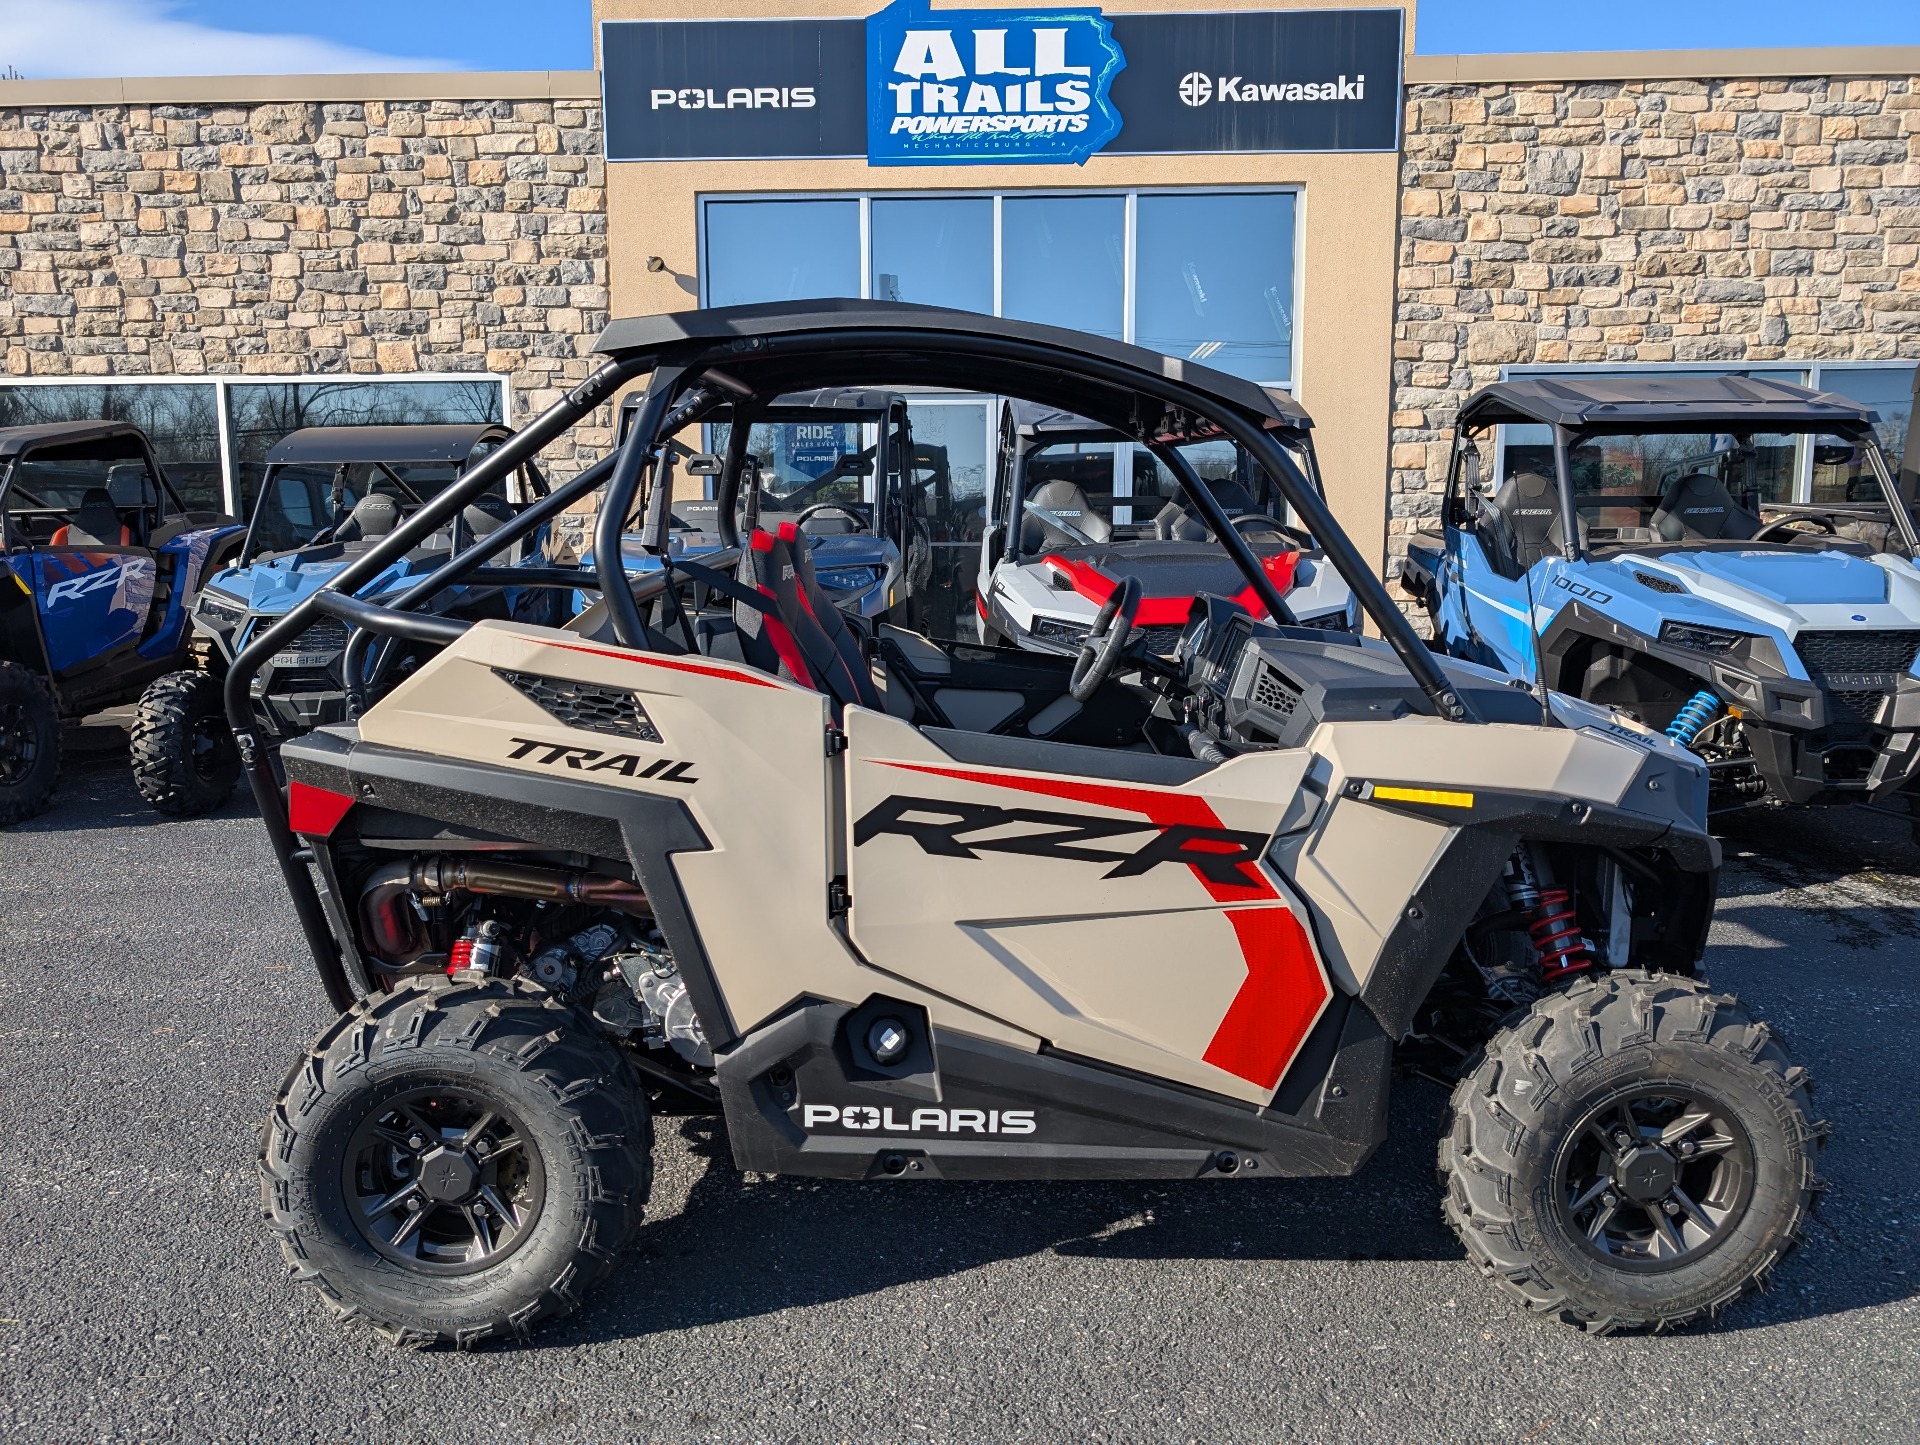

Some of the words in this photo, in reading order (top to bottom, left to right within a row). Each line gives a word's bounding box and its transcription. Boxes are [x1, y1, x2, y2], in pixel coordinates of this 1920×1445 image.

[893, 27, 1091, 81] ALL
[650, 87, 817, 110] POLARIS
[888, 79, 1091, 114] TRAILS
[1218, 74, 1365, 102] Kawasaki
[889, 113, 1090, 135] POWERSPORTS
[796, 425, 834, 440] RIDE
[816, 440, 840, 448] EVENT
[360, 502, 391, 511] RZR
[1512, 508, 1552, 516] GENERAL
[1683, 506, 1724, 514] GENERAL
[46, 557, 147, 609] RZR
[1551, 574, 1614, 605] 1000
[272, 655, 329, 665] POLARIS
[1608, 723, 1657, 748] TRAIL
[506, 737, 700, 785] TRAIL
[853, 794, 1272, 889] RZR
[803, 1104, 1037, 1135] POLARIS
